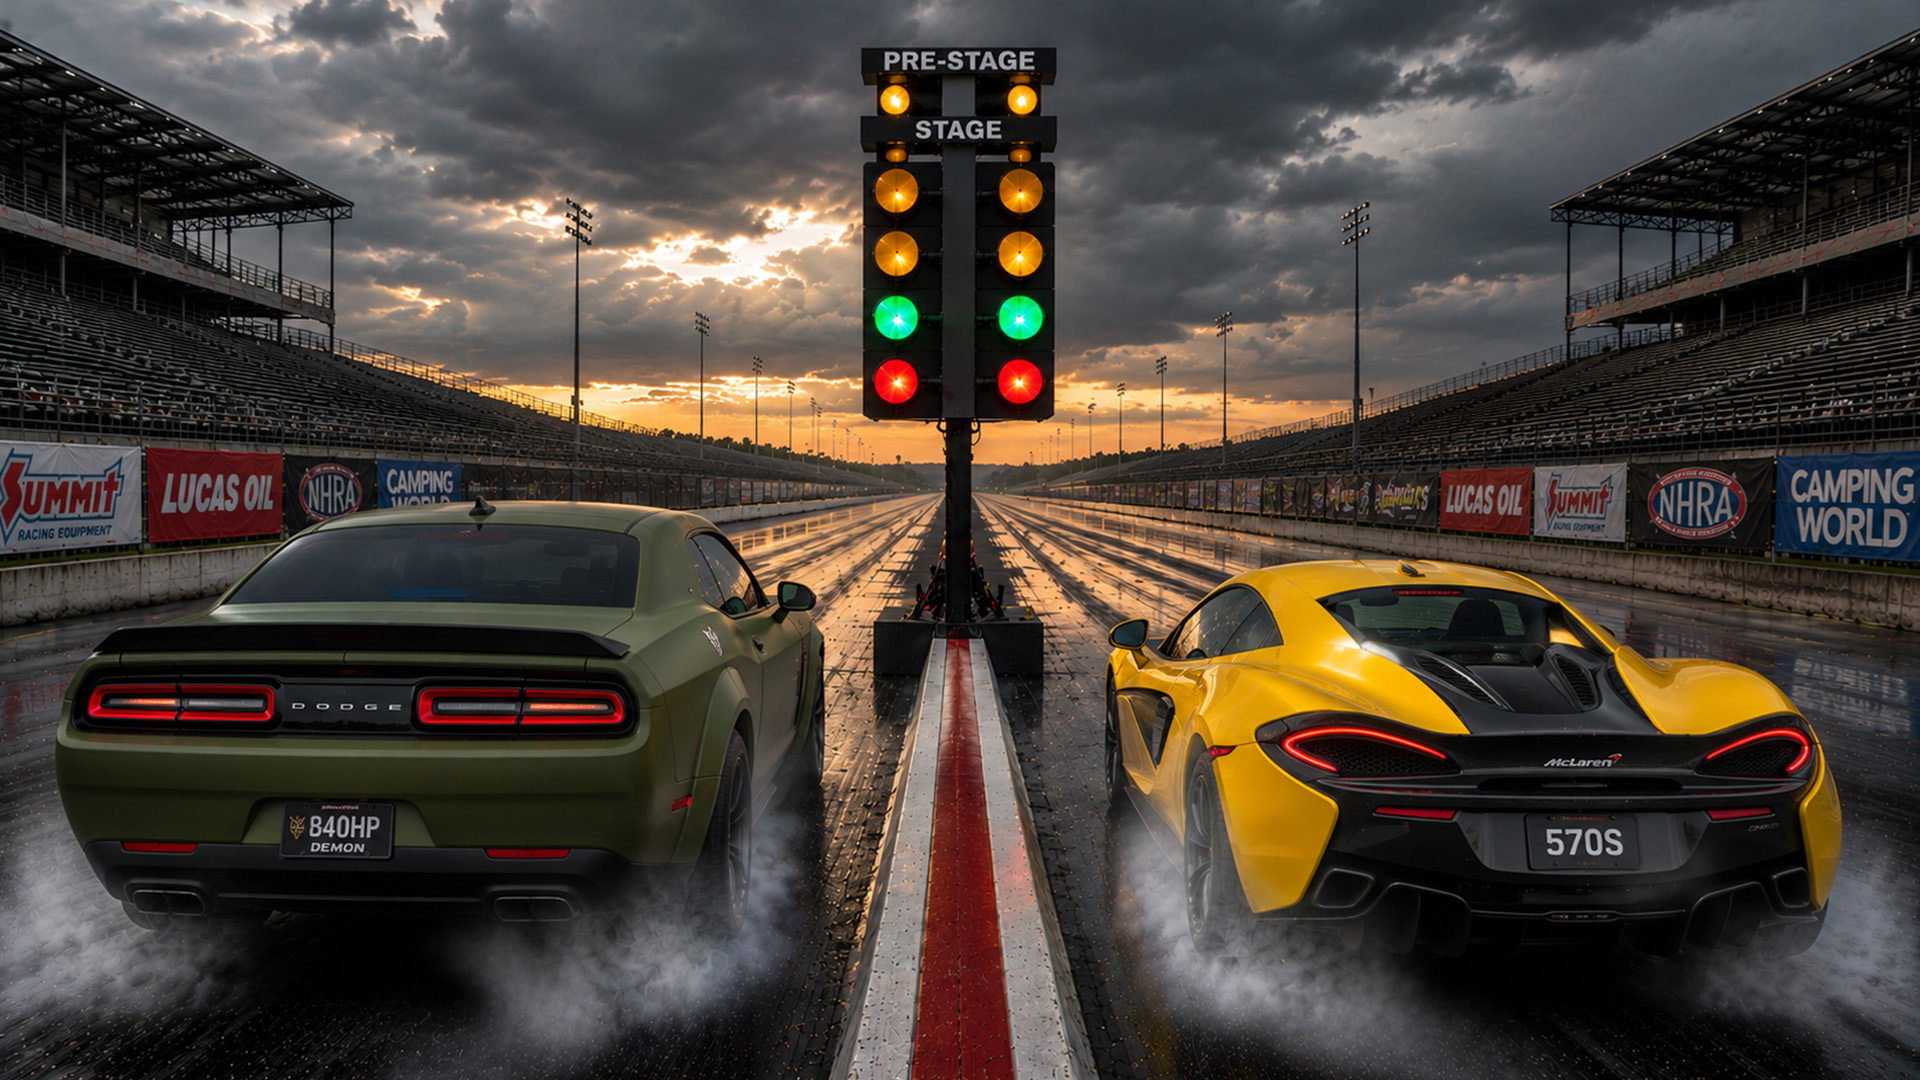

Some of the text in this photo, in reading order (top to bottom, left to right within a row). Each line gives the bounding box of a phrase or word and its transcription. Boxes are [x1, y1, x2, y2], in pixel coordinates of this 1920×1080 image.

[884, 51, 1035, 71] PRE-STAGE
[915, 120, 1002, 140] STAGE
[161, 473, 274, 514] LUCAS OIL
[308, 474, 357, 514] NHRA
[386, 468, 454, 495] CAMPING
[1791, 467, 1915, 505] CAMPING
[1445, 484, 1495, 515] LUCAS
[1497, 484, 1523, 516] OIL
[1659, 480, 1733, 527] NHRA
[17, 524, 112, 541] RACING EQUIPMENT
[1796, 506, 1908, 548] WORLD
[291, 702, 402, 711] DODGE
[1543, 757, 1614, 767] McLaren
[309, 815, 380, 838] 840HP
[310, 842, 365, 853] DEMON
[1546, 828, 1624, 856] 570S
